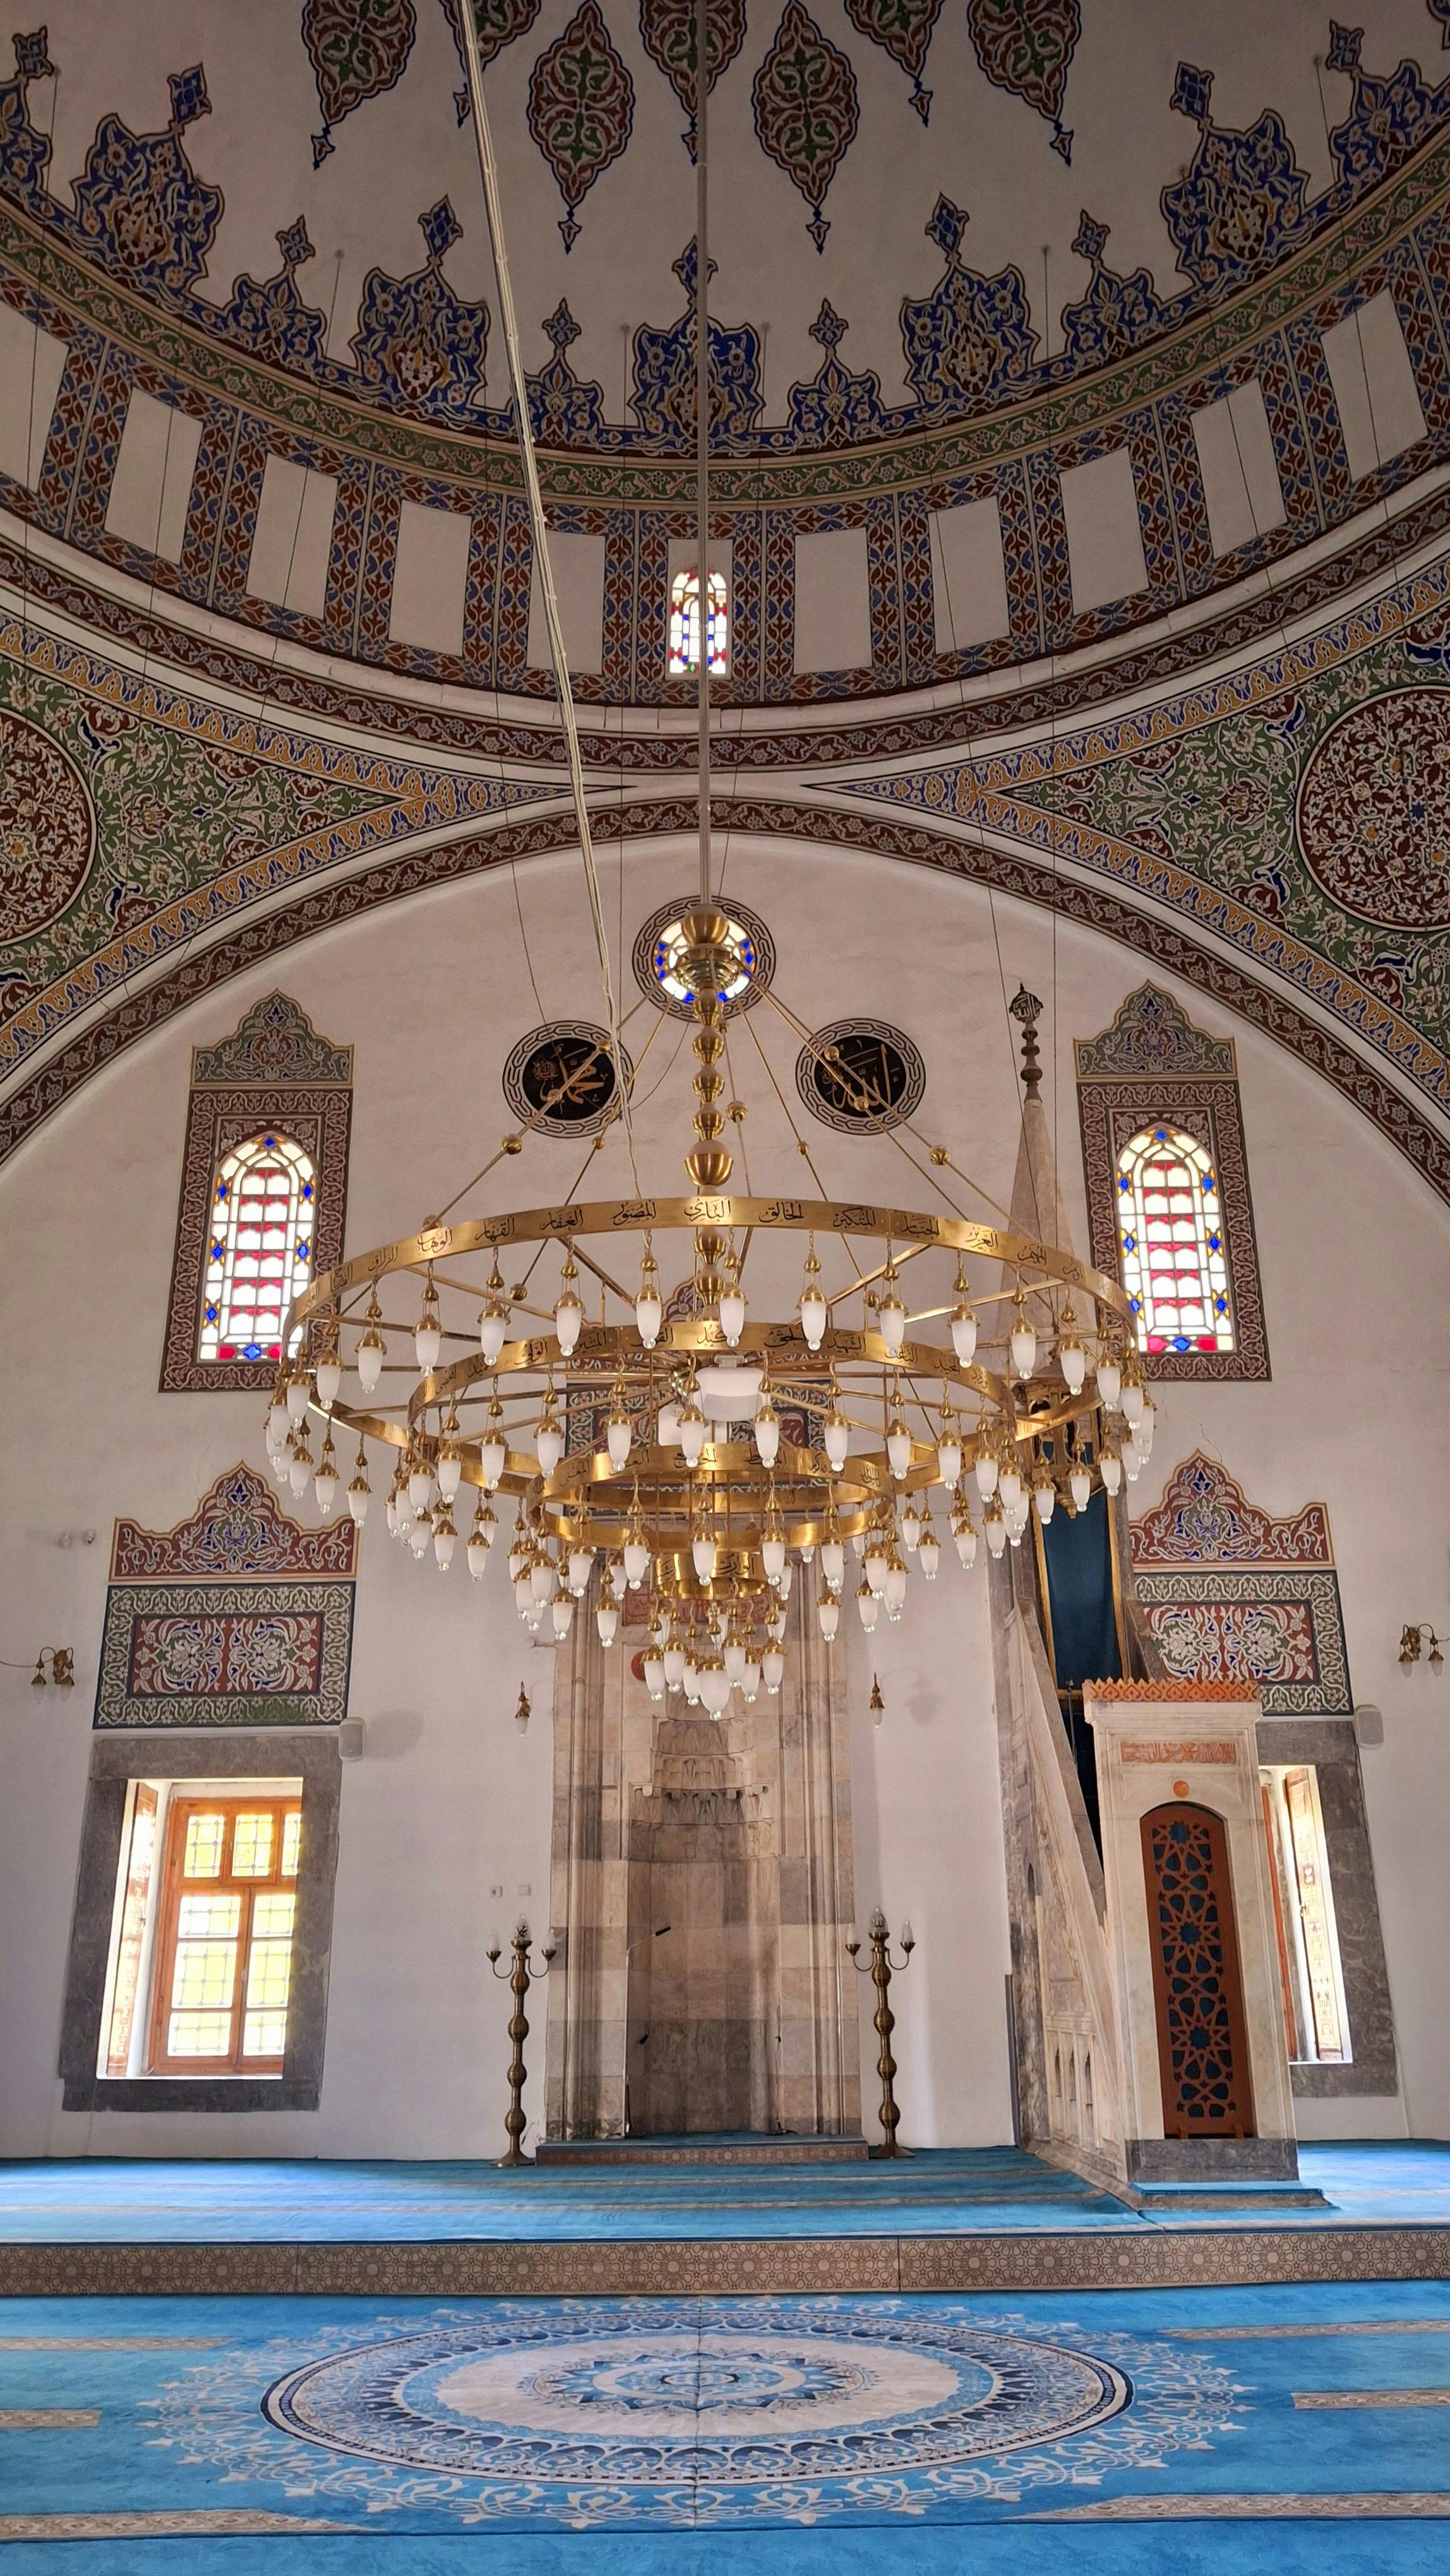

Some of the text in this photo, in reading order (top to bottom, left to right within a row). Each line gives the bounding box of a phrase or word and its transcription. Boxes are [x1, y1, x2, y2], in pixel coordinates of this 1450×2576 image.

[831, 1042, 892, 1109] الله
[539, 1206, 584, 1230] الغفار
[611, 1200, 657, 1225] المصور
[758, 1201, 805, 1223] الخالق
[474, 1215, 515, 1242] القهار
[899, 1215, 940, 1239] الجبار
[697, 1325, 728, 1347] كيل
[763, 1324, 806, 1348] الحق
[827, 1331, 866, 1355] الشهيد
